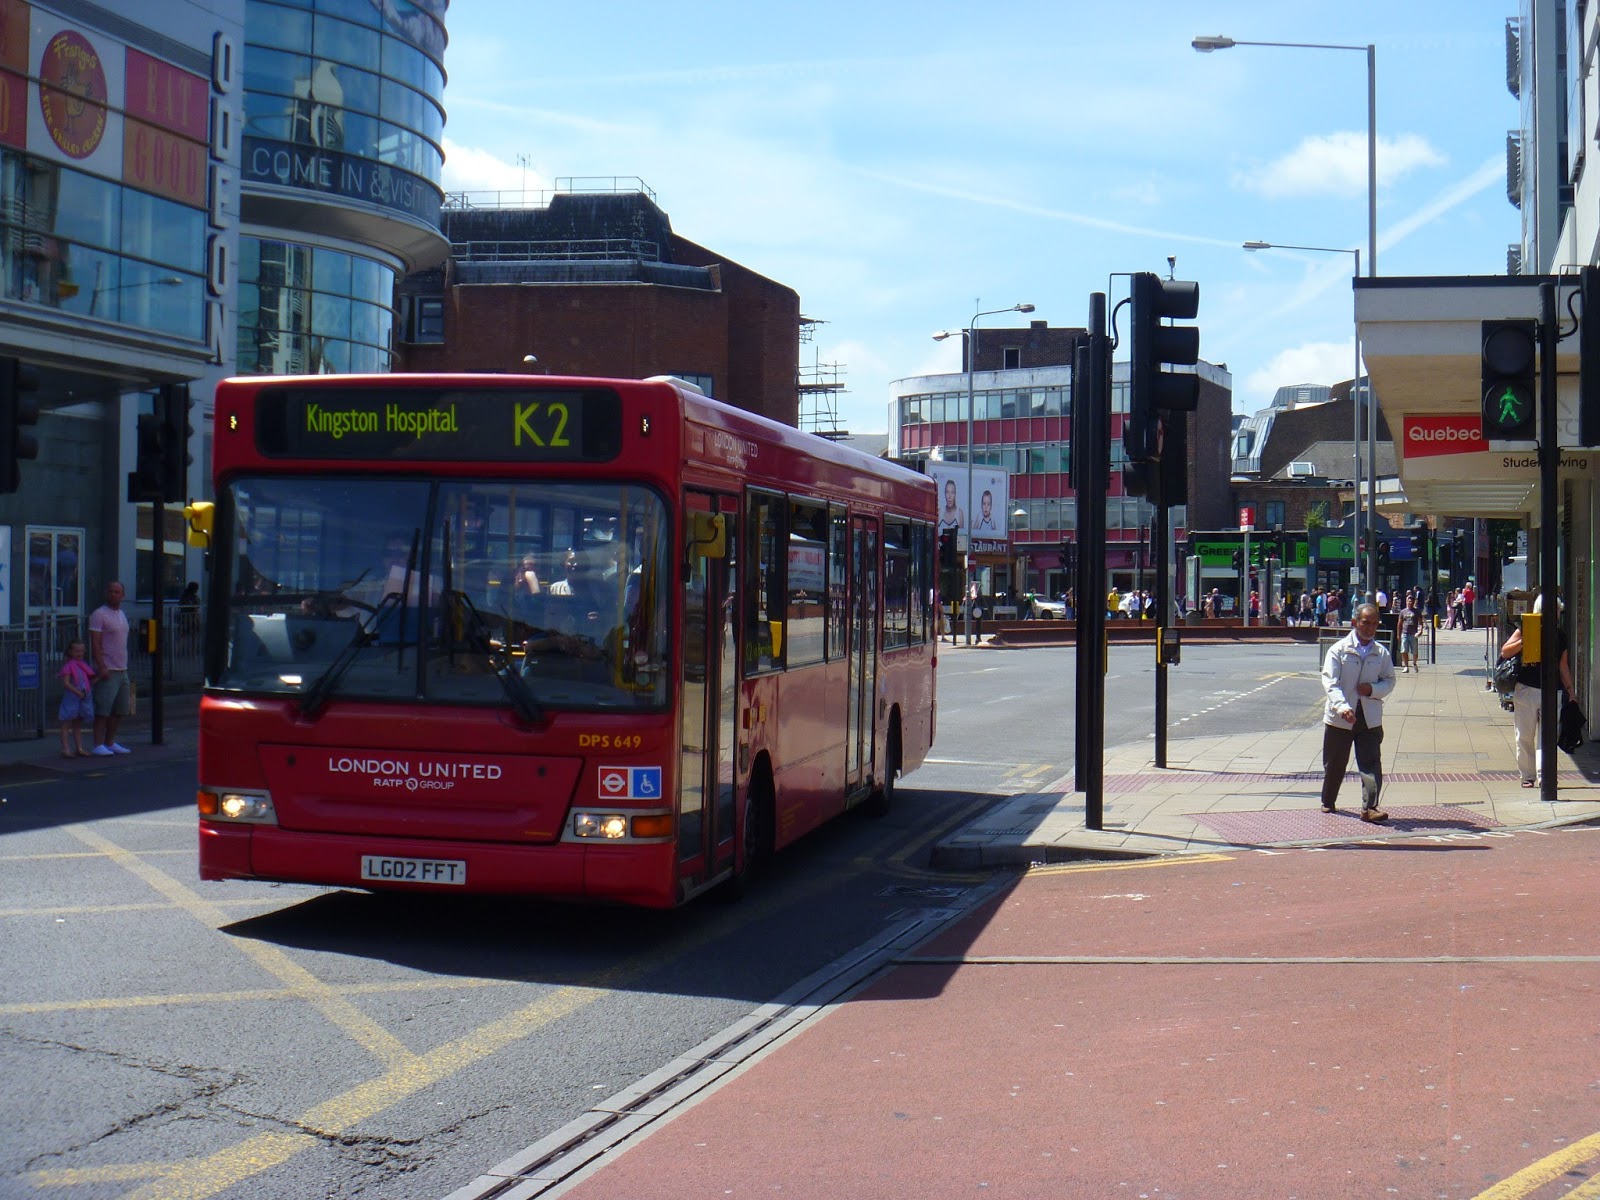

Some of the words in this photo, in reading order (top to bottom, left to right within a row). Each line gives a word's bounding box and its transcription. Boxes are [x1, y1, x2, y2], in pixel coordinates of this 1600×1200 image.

[53, 35, 97, 72] Frangos
[146, 63, 192, 128] EAT
[134, 125, 198, 195] GOOD
[208, 31, 232, 365] ODEON
[252, 147, 333, 187] COME
[341, 162, 362, 193] IN
[370, 170, 384, 198] &
[390, 175, 424, 212] VISIT
[306, 403, 379, 439] Kingston
[385, 403, 459, 439] Hospital
[514, 402, 570, 446] K2
[1408, 426, 1481, 441] Quebec
[579, 734, 611, 748] DPS
[614, 734, 642, 749] 649
[328, 757, 409, 775] LONDON
[419, 763, 502, 780] UNITED
[374, 778, 403, 788] RATP
[419, 780, 455, 790] GROUP
[368, 859, 416, 879] LG02
[422, 862, 458, 881] FFT
